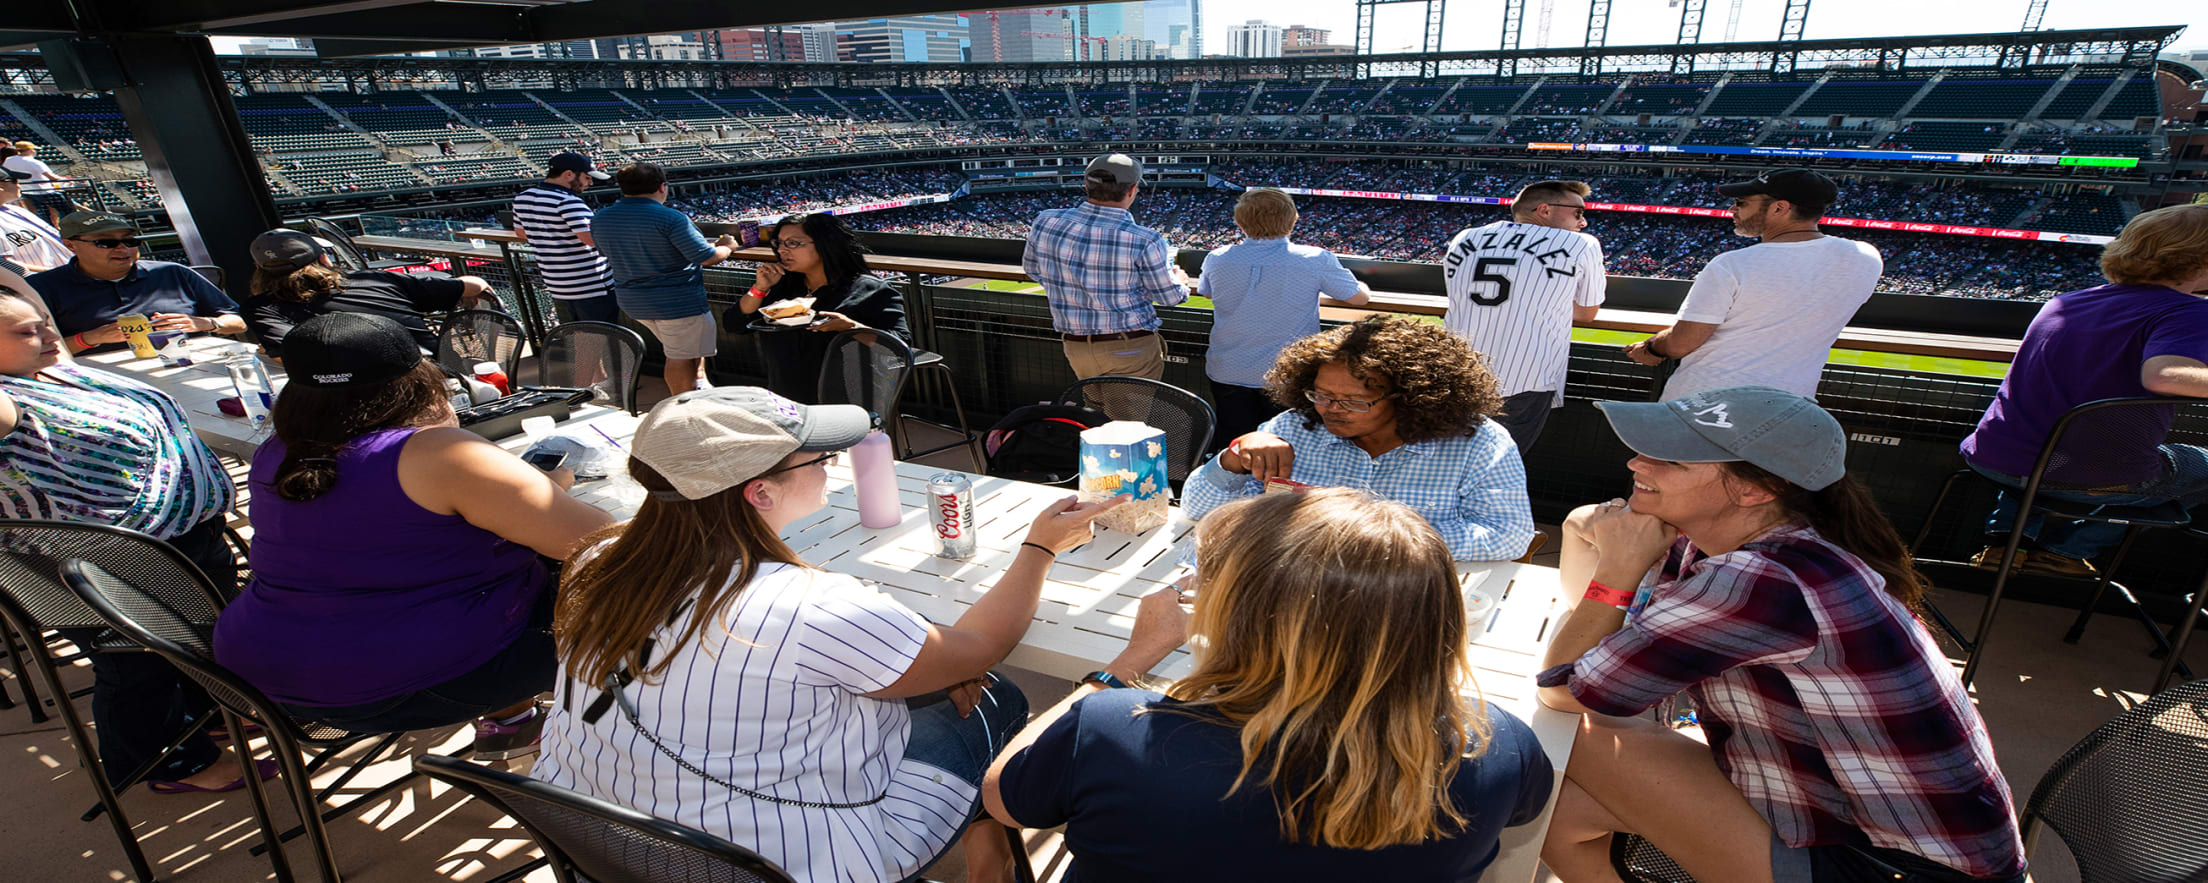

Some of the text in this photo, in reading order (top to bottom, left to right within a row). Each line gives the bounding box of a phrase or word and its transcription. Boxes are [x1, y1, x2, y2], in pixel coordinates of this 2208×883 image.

[1447, 233, 1576, 279] GONZALEZ
[1470, 257, 1518, 307] 5
[312, 372, 353, 380] COLORADO
[936, 492, 962, 539] Coors
